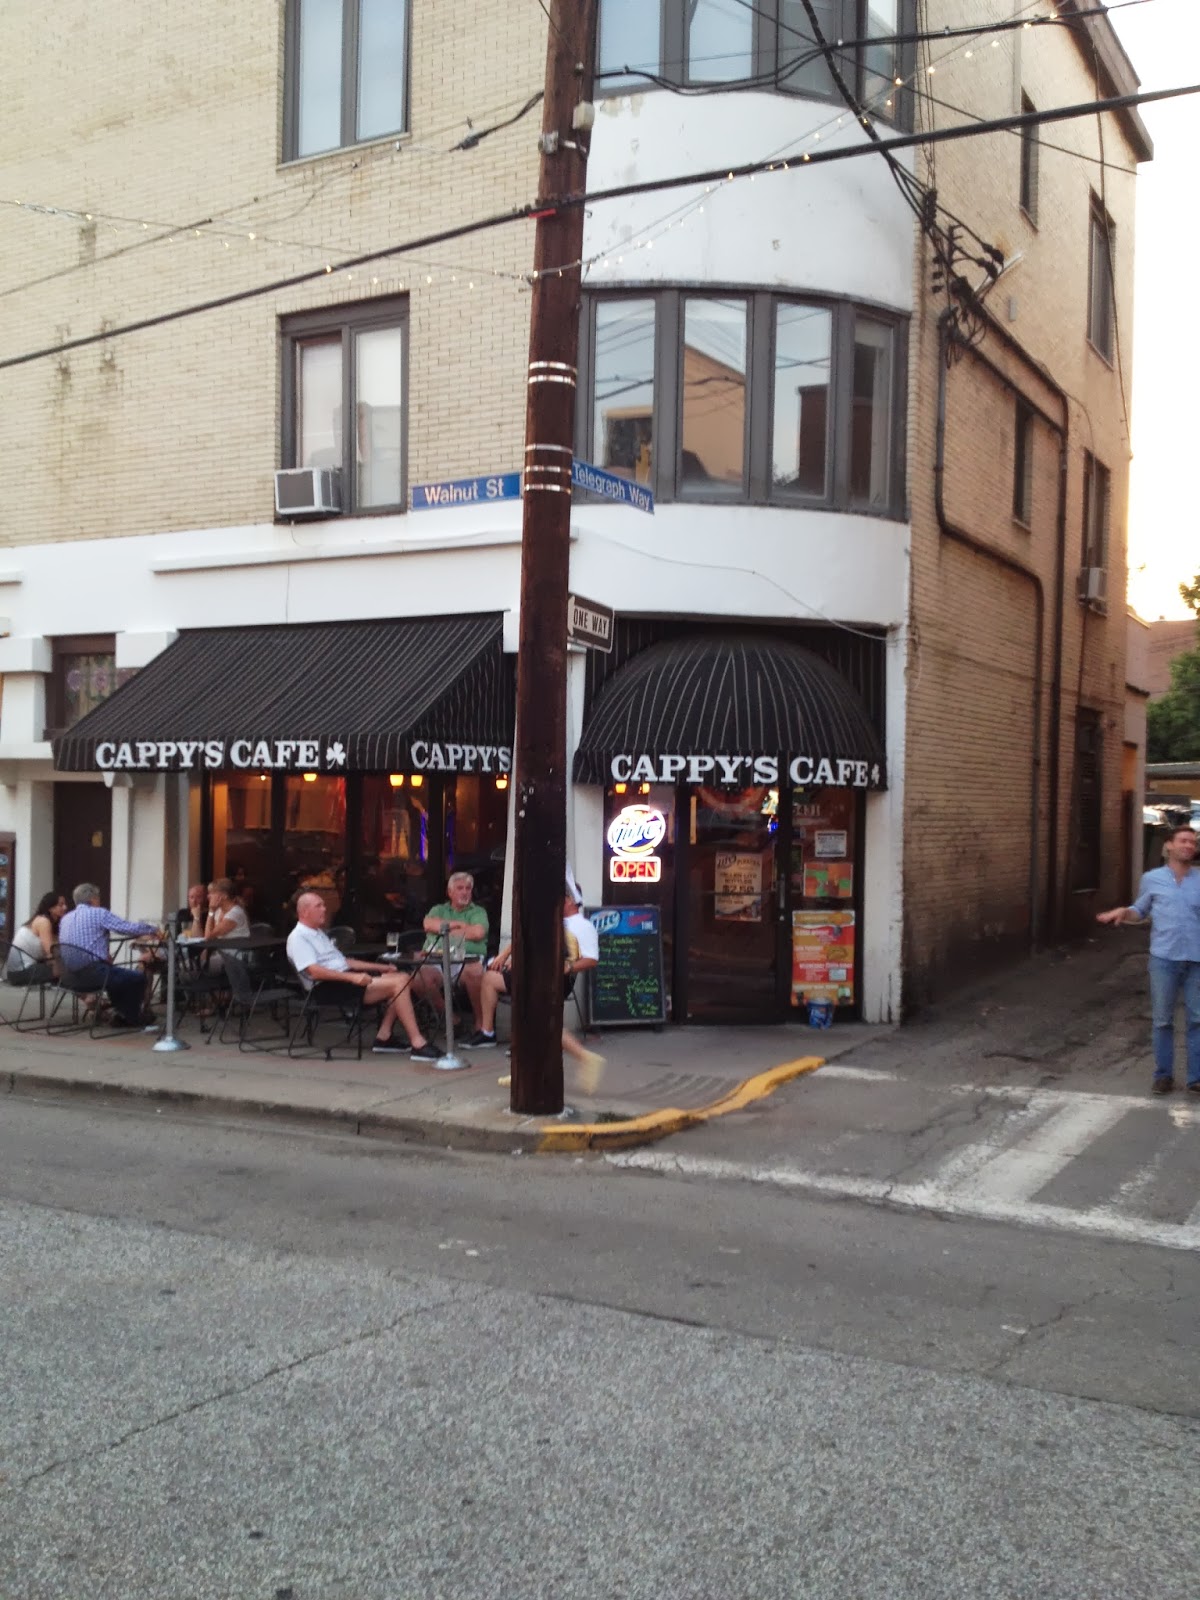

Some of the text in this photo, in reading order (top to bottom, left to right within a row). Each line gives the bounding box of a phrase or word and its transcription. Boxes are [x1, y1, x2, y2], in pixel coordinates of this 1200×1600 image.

[424, 478, 504, 505] Walnut St
[573, 462, 650, 511] Telegraph Way
[573, 607, 608, 635] ONE WAY
[95, 739, 319, 768] CAPPY'S CAFE
[410, 740, 512, 772] CAPPY'S
[610, 754, 868, 787] CAPPY'S CAFE
[614, 861, 657, 878] OPEN
